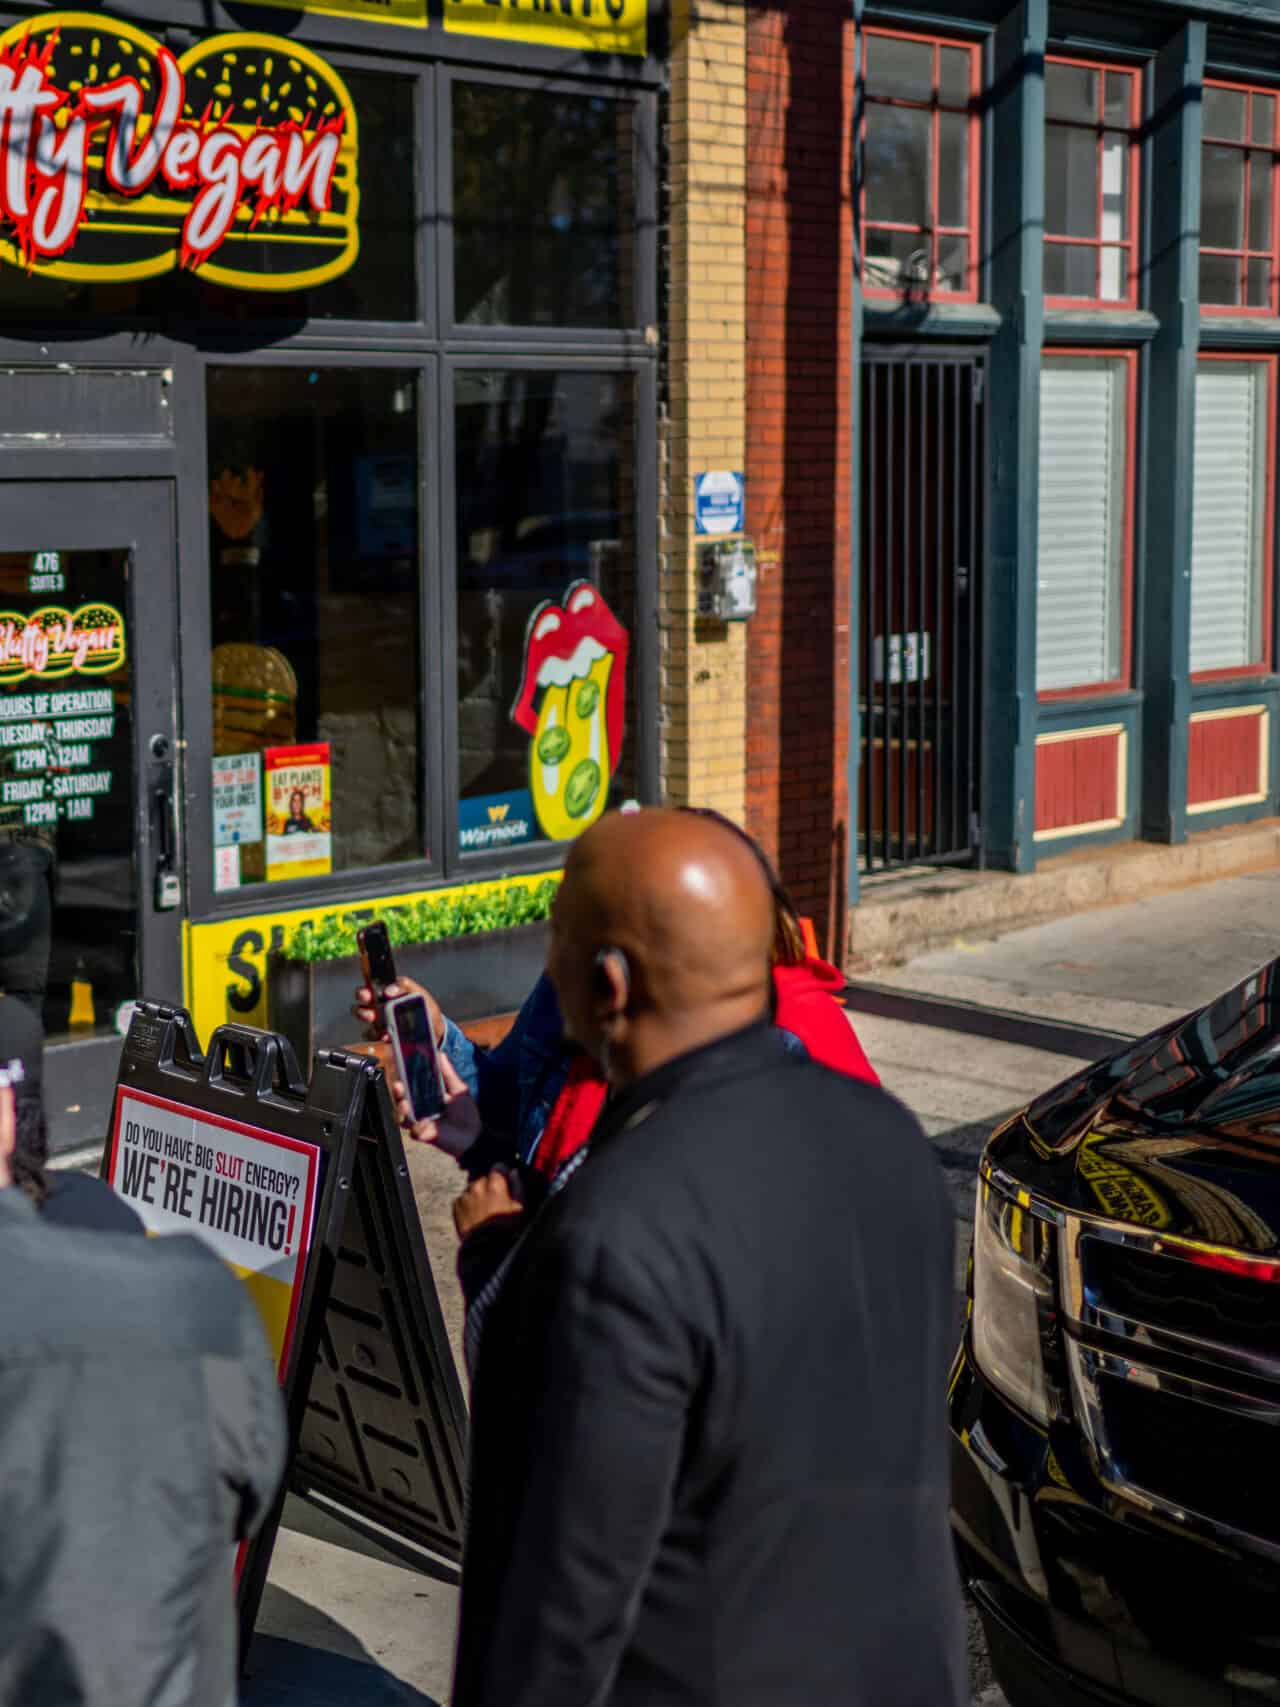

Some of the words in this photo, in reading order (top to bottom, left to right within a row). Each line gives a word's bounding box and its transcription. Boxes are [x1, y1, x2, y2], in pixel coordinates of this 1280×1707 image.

[83, 48, 343, 254] Vegan
[33, 552, 59, 573] 476
[47, 614, 116, 667] Vegan
[34, 693, 49, 714] OF
[51, 689, 113, 713] OPERATION
[54, 716, 113, 740] THURSDAY
[15, 749, 47, 769] 12PM
[58, 744, 90, 767] 12AM
[3, 778, 44, 802] FRIDAY
[53, 771, 111, 797] SATURDAY
[272, 771, 289, 786] EAT
[24, 801, 57, 823] 12PM
[67, 797, 92, 819] 1AM
[459, 819, 528, 848] Warnock
[125, 1120, 140, 1146] DO
[142, 1127, 164, 1153] YOU
[164, 1133, 194, 1164] HAVE
[194, 1143, 215, 1171] BIG
[215, 1151, 245, 1181] SLUT
[245, 1161, 300, 1201] ENERGY?
[122, 1147, 198, 1218] WE'RE
[199, 1174, 297, 1258] HIRING!
